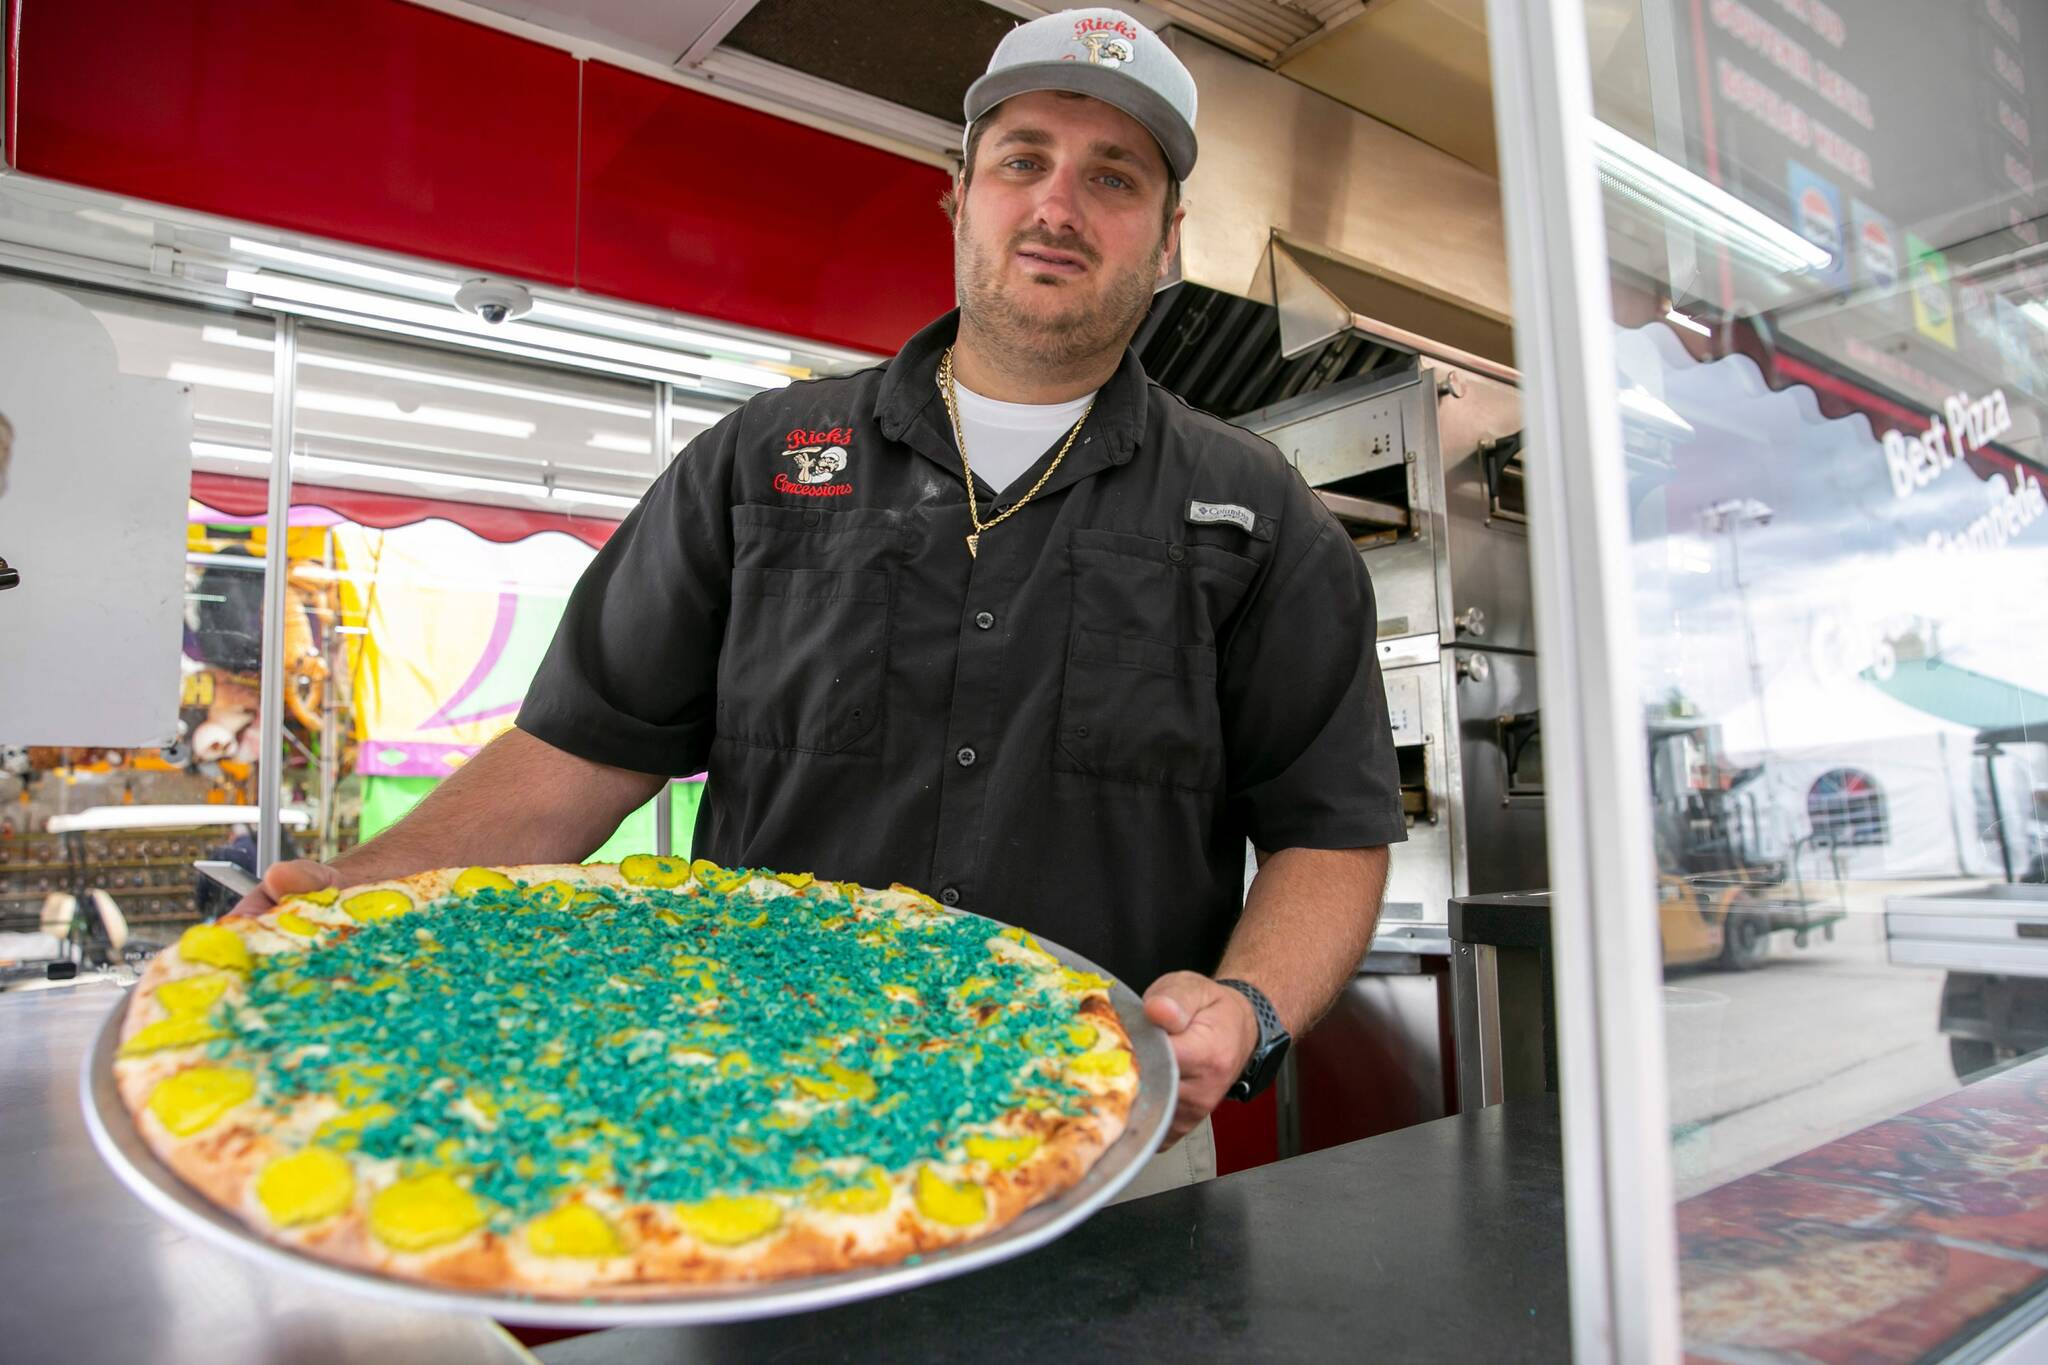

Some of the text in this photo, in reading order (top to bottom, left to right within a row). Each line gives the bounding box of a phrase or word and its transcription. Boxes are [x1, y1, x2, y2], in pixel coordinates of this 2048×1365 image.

[1882, 389, 2012, 498] Best Pizza
[773, 472, 853, 496] Concessions
